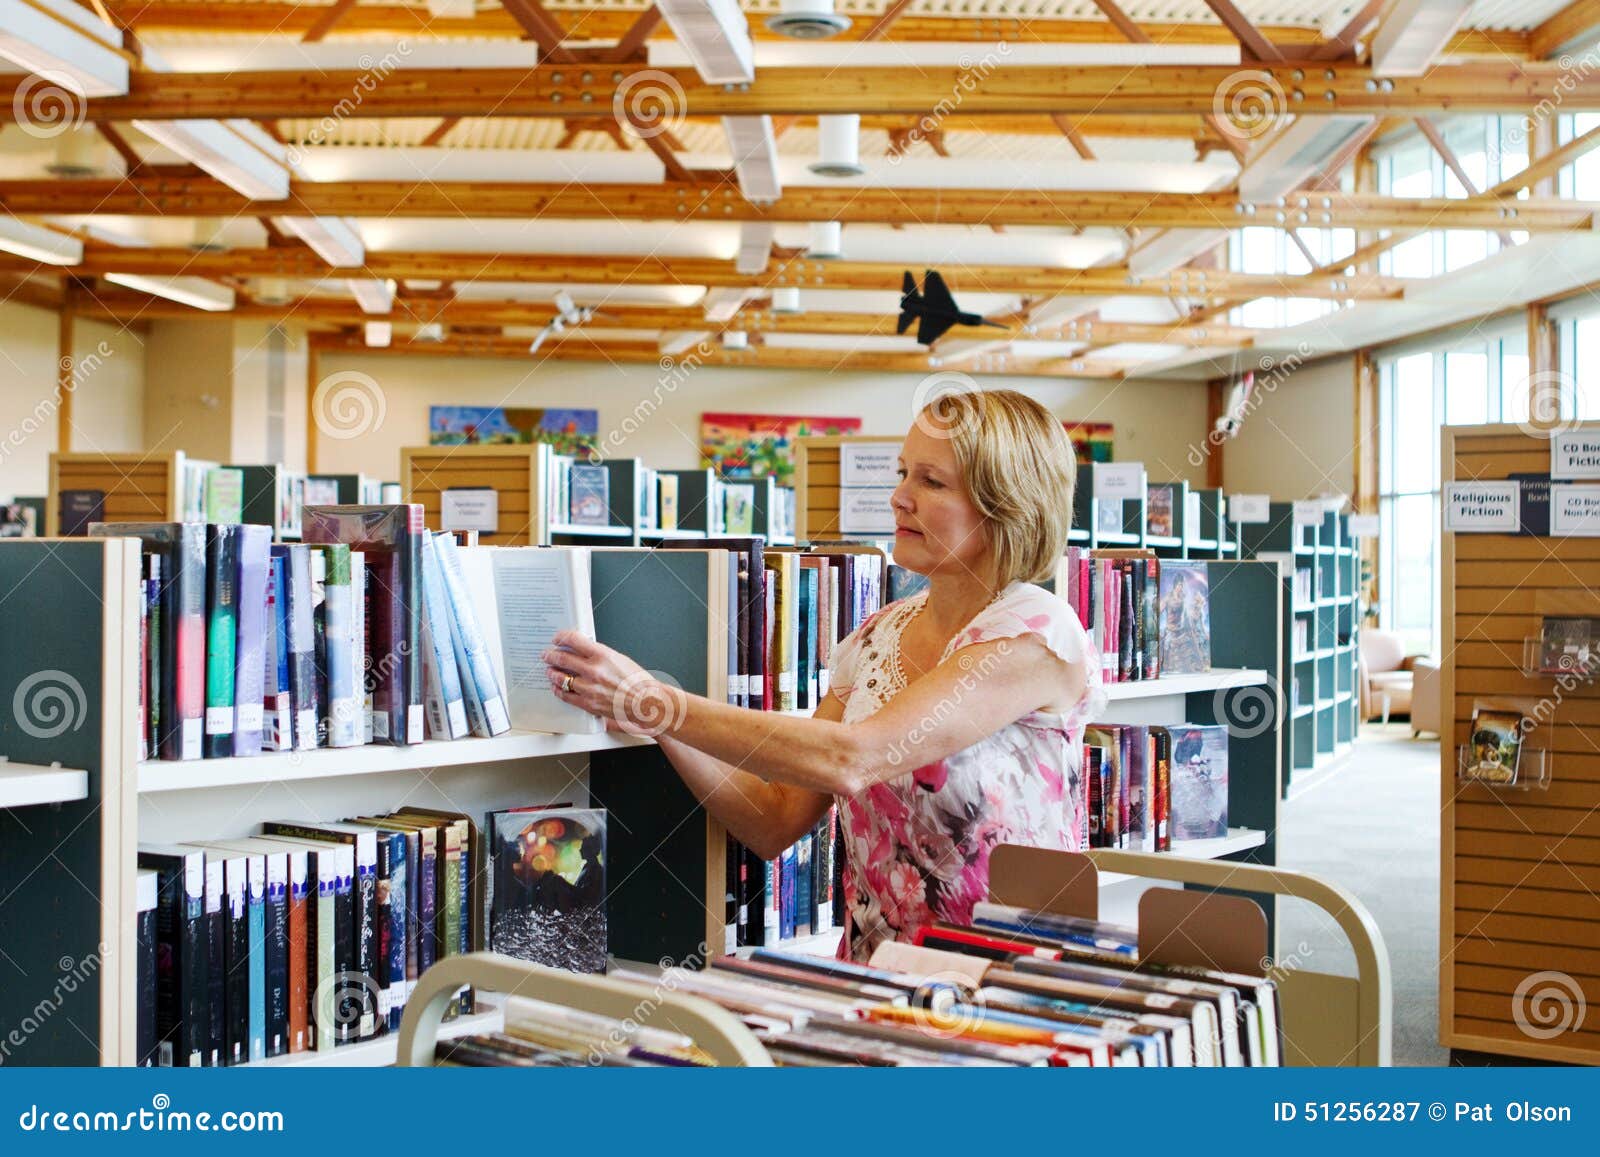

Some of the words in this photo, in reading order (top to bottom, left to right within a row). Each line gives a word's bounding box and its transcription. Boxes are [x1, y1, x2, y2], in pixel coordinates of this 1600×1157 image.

[1563, 443, 1578, 453] CD
[1453, 493, 1511, 504] Religious
[1461, 507, 1503, 516] Fiction
